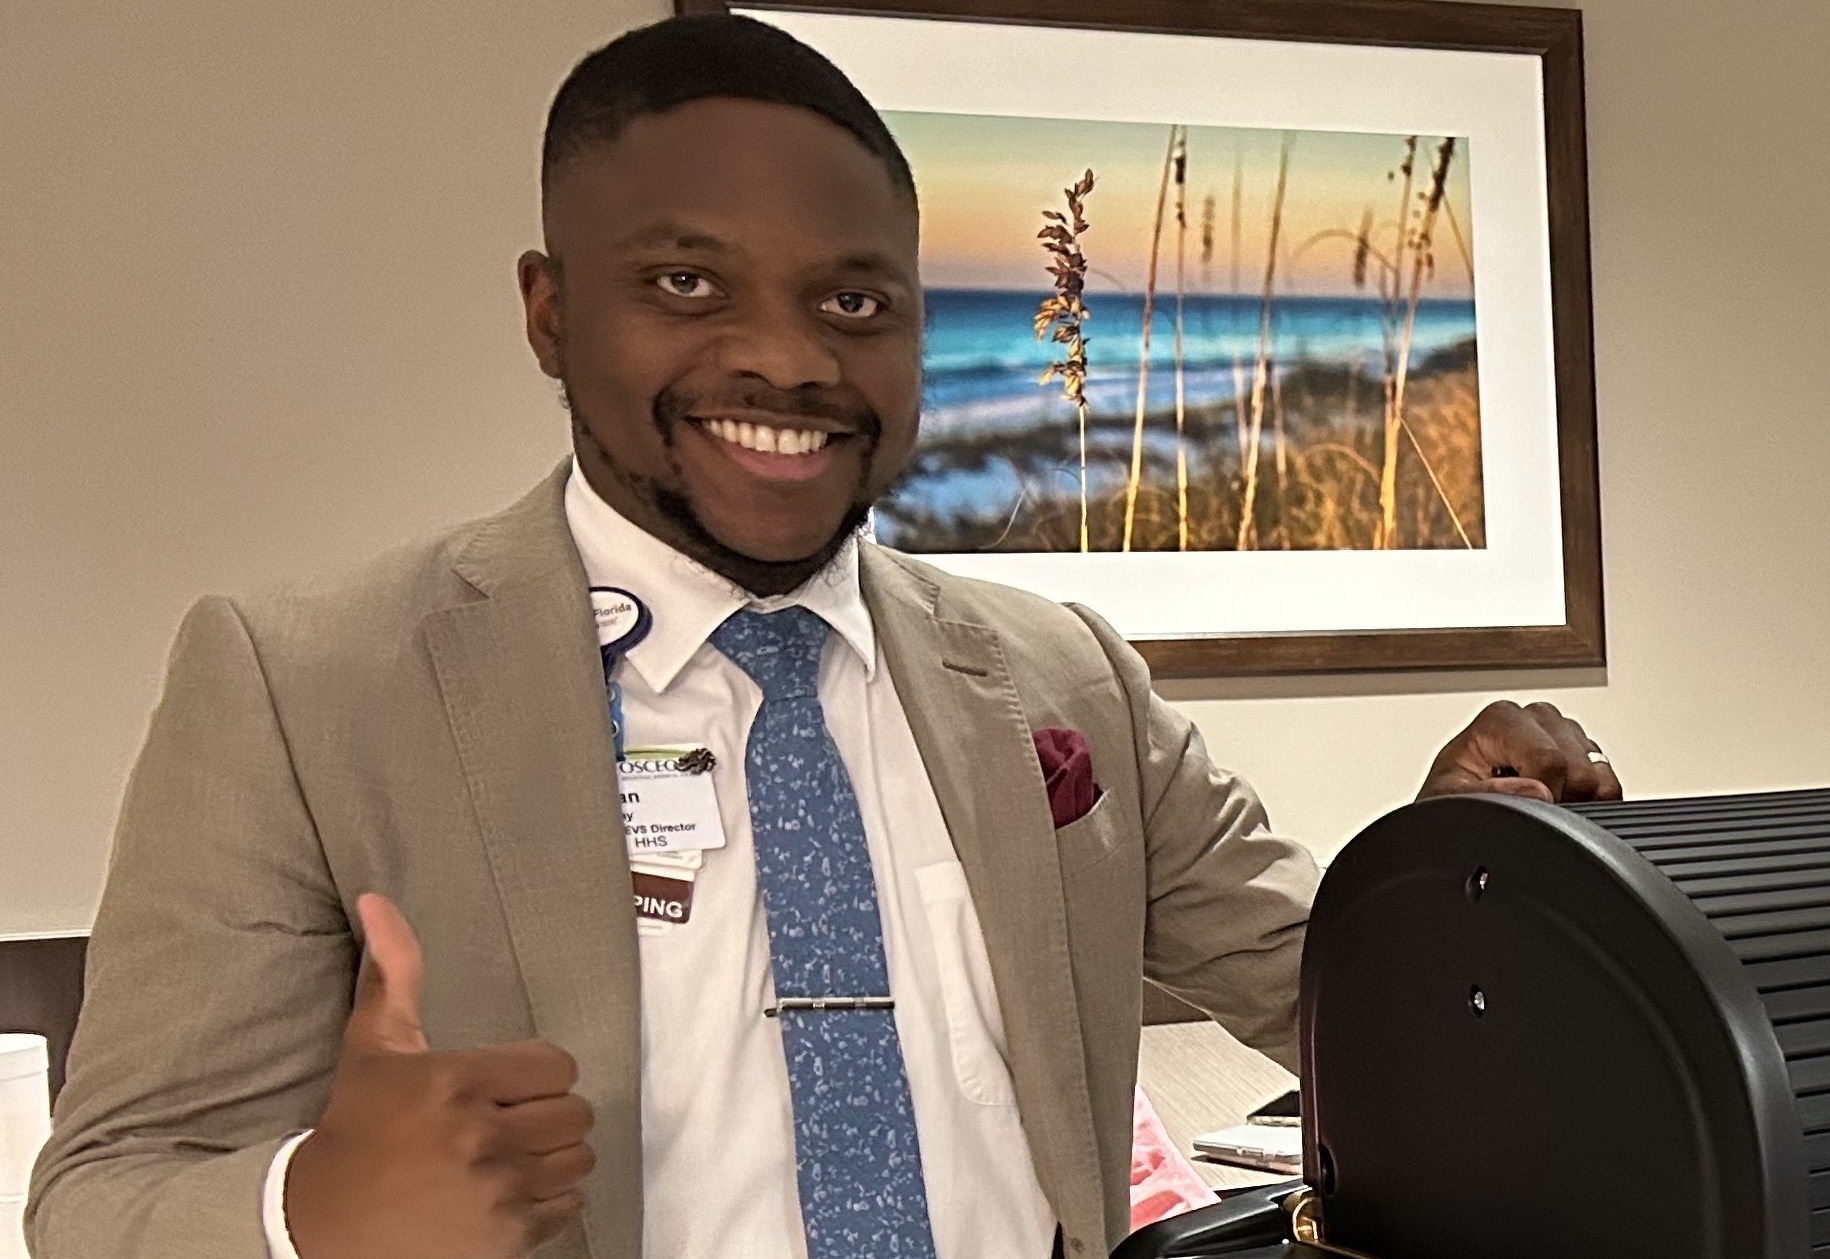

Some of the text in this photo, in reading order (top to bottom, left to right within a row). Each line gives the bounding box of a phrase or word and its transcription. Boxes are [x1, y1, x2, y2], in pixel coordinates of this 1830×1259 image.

[620, 760, 680, 774] OSCEO
[620, 792, 640, 804] an
[650, 823, 696, 834] Director
[634, 836, 668, 848] HHS
